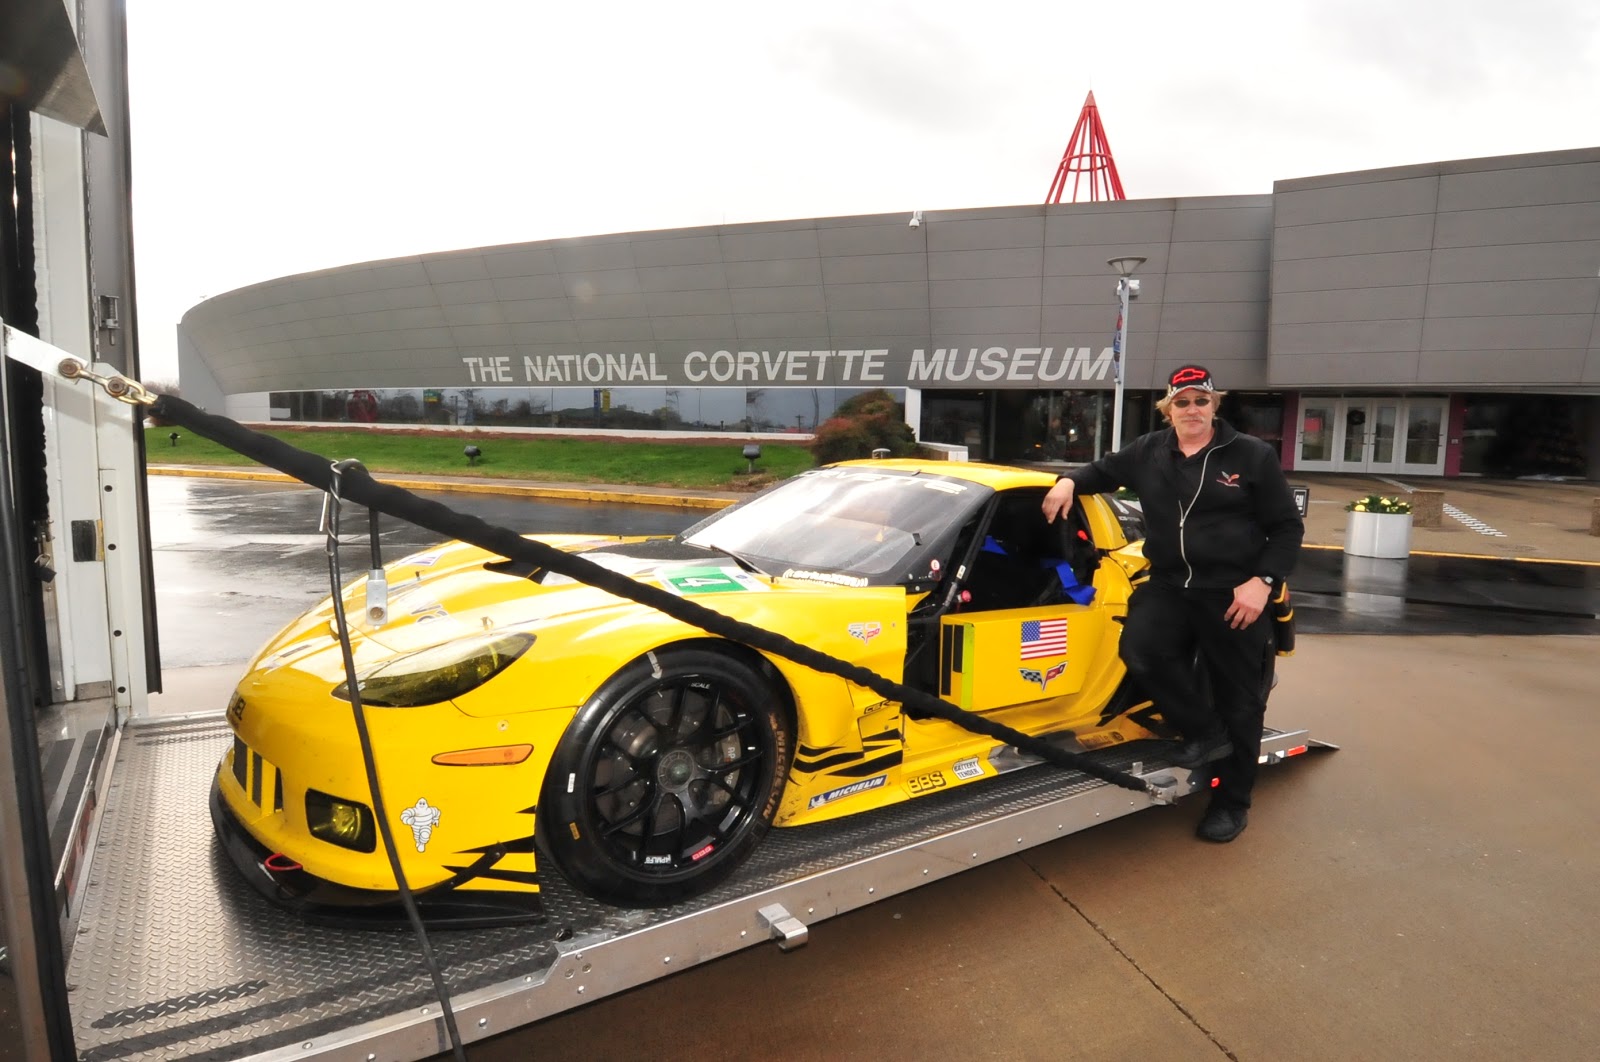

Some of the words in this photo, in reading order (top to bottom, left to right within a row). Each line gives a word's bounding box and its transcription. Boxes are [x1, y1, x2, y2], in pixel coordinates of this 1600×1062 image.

[463, 357, 513, 382] THE
[523, 353, 668, 382] NATIONAL
[684, 349, 889, 382] CORVETTE
[907, 347, 1114, 381] MUSEUM
[677, 577, 732, 588] 4
[763, 730, 786, 820] MICHELIN
[953, 761, 977, 773] BATTERY
[957, 768, 979, 779] TENDER
[828, 777, 883, 800] MICHELIN
[907, 771, 947, 794] BBS
